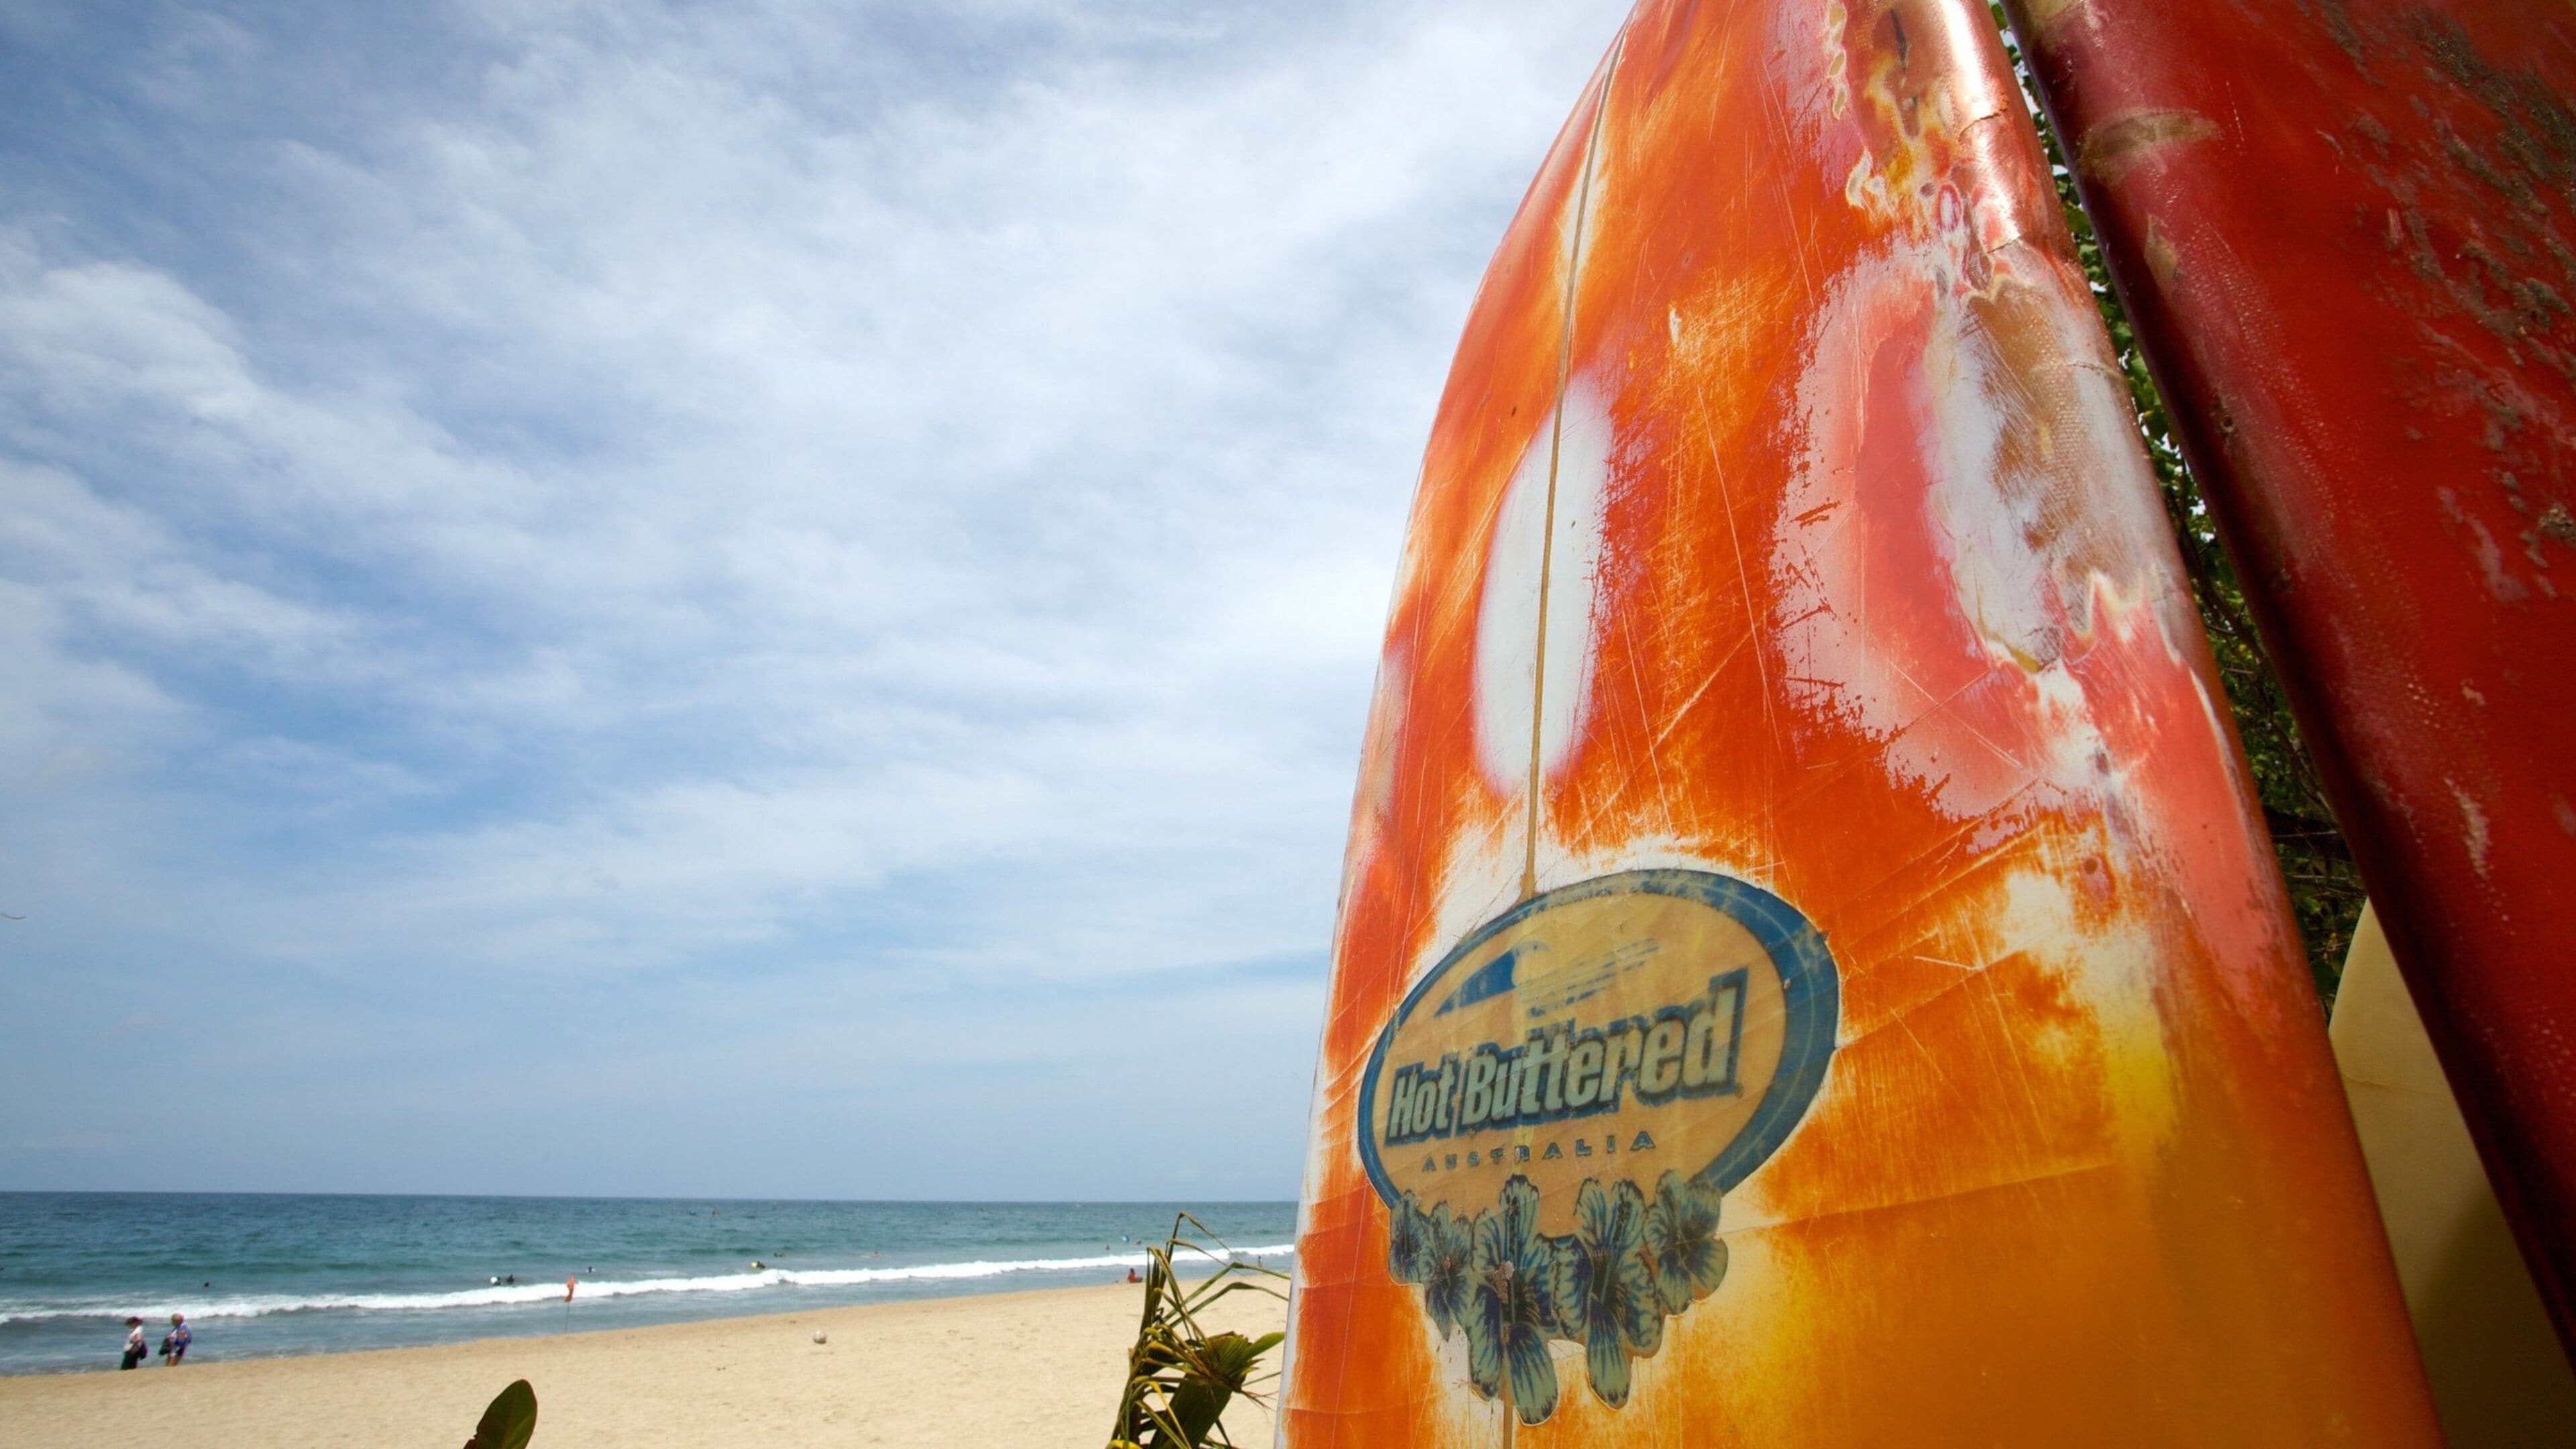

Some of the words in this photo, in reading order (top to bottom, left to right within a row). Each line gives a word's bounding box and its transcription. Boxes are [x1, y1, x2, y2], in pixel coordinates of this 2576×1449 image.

[1386, 1056, 1458, 1143] Hot
[1458, 974, 1744, 1132] Buttered
[1421, 1130, 1657, 1173] AUSTRALIA
